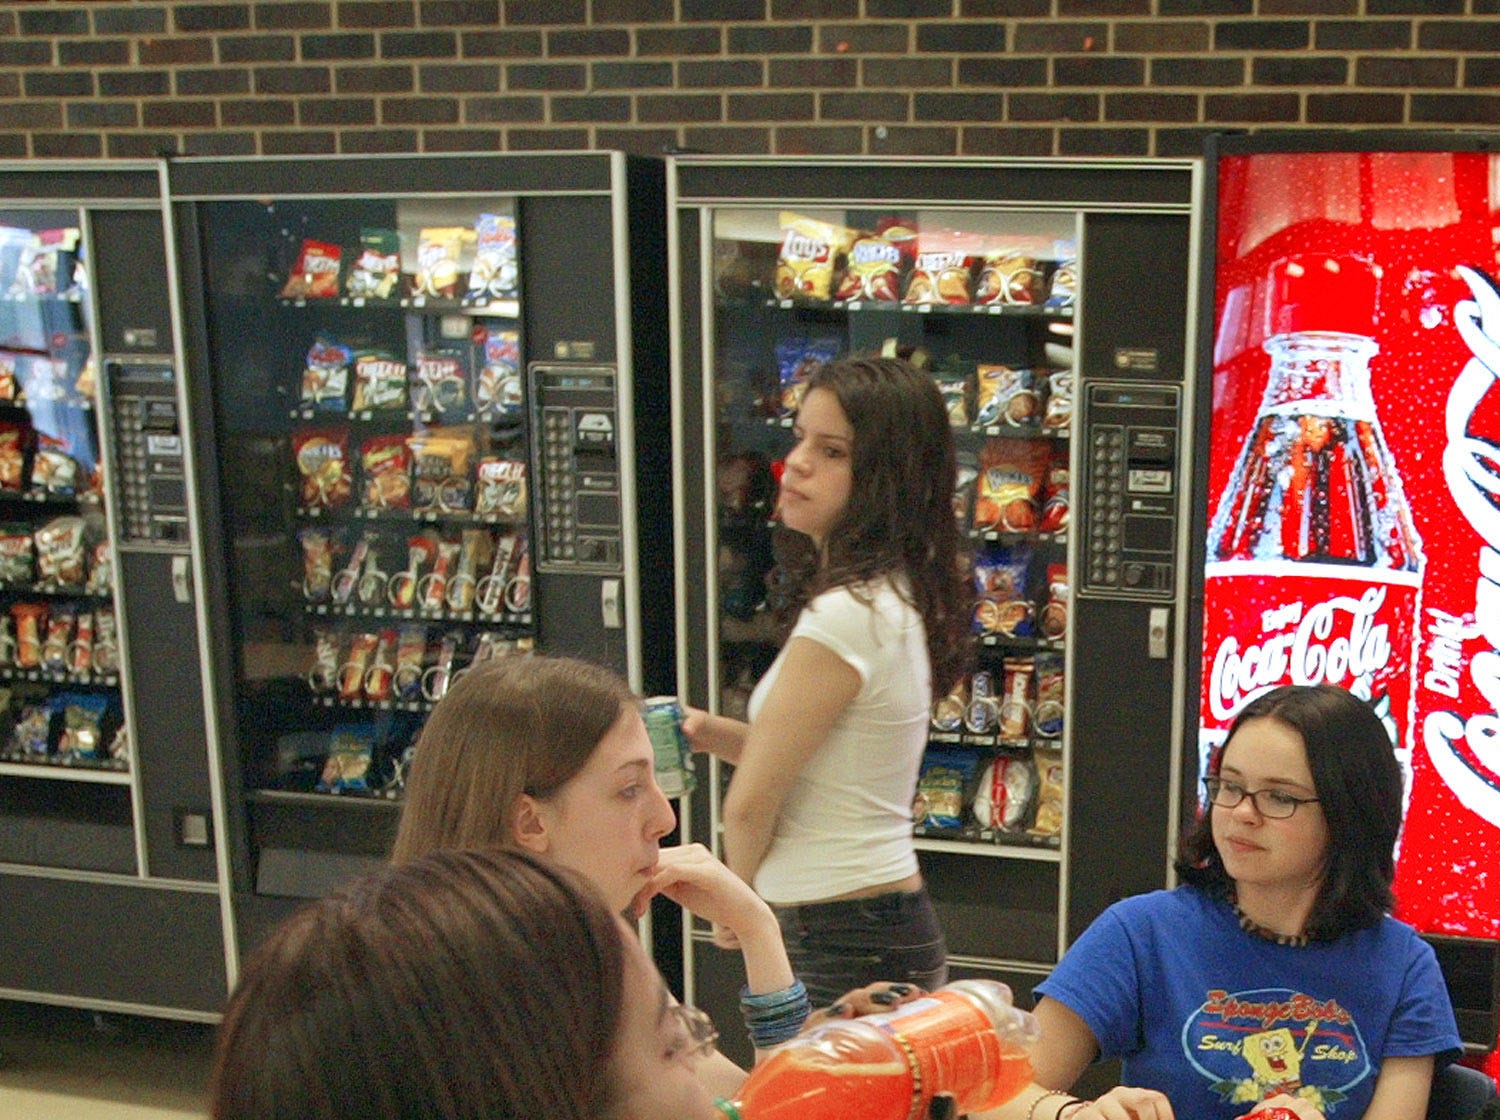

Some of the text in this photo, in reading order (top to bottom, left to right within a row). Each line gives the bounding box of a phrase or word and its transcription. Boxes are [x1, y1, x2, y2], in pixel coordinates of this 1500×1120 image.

[1210, 584, 1391, 721] Coca-Cola
[1198, 1034, 1358, 1065] Surf Shop
